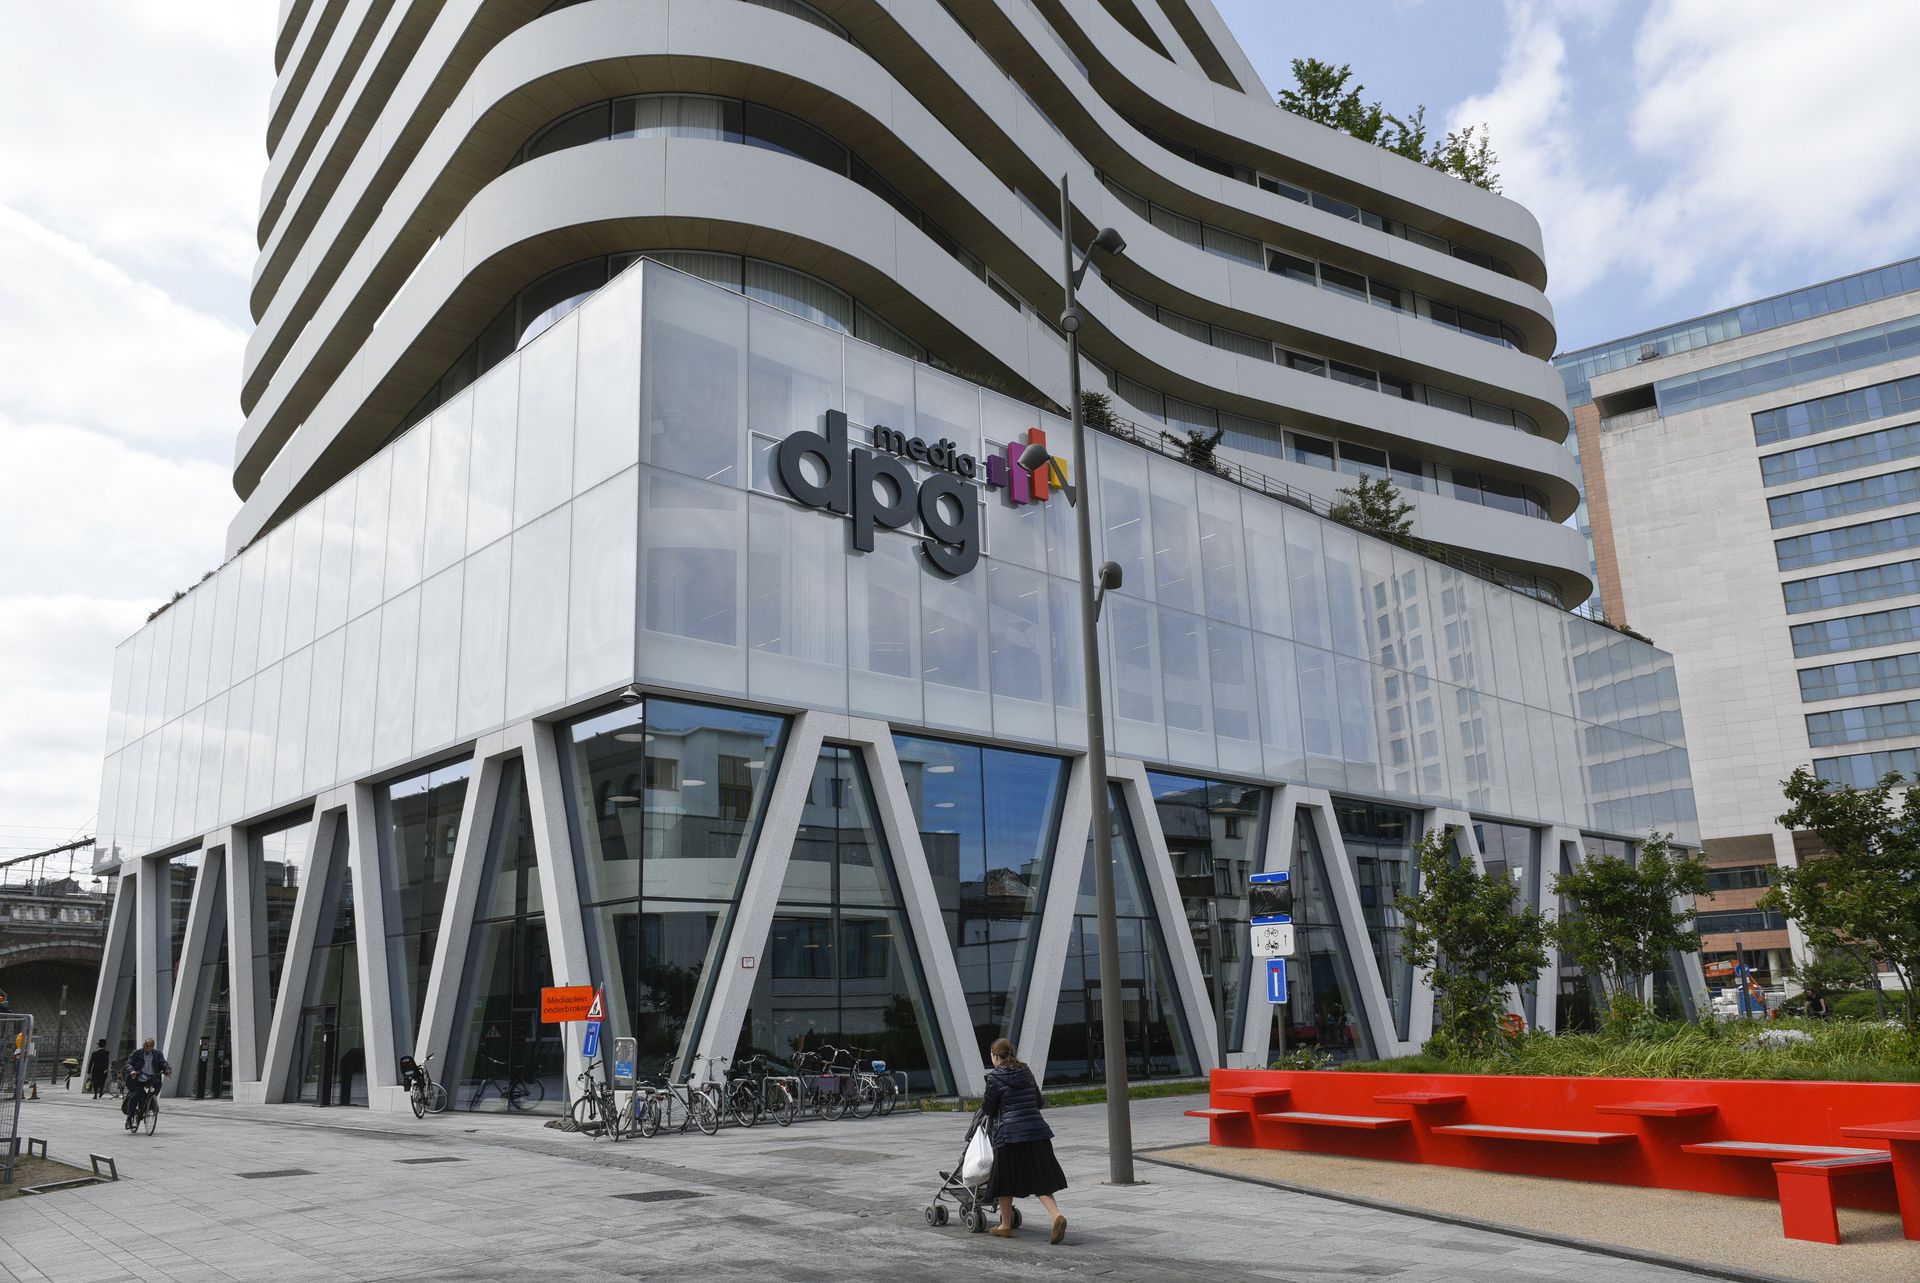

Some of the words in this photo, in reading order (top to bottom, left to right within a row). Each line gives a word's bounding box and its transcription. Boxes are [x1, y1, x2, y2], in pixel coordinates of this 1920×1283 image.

[873, 424, 976, 478] media
[778, 409, 980, 576] dpg
[547, 995, 587, 1004] Mediaplein
